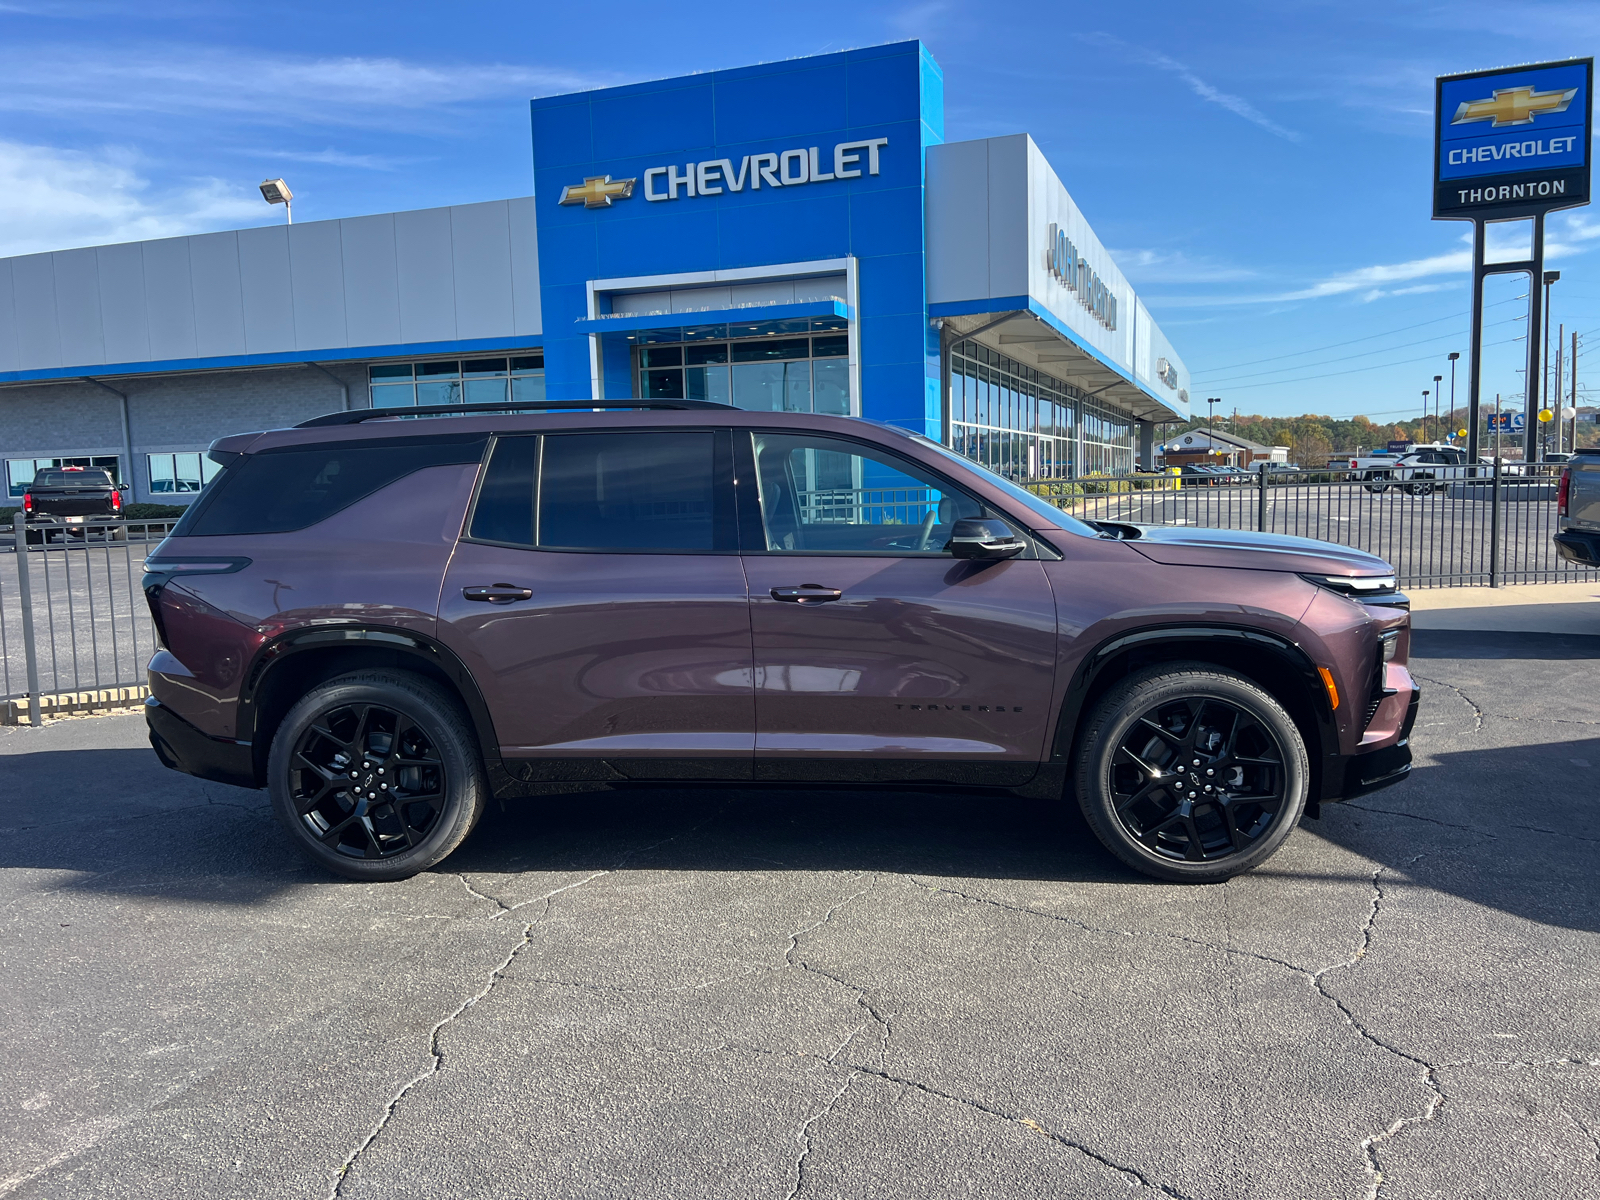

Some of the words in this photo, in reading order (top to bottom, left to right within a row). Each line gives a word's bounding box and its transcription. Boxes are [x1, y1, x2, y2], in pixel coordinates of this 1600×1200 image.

[1448, 136, 1577, 165] CHEVROLET
[644, 137, 888, 201] CHEVROLET
[1458, 180, 1565, 203] THORNTON
[894, 703, 1023, 713] TRAVERSE
